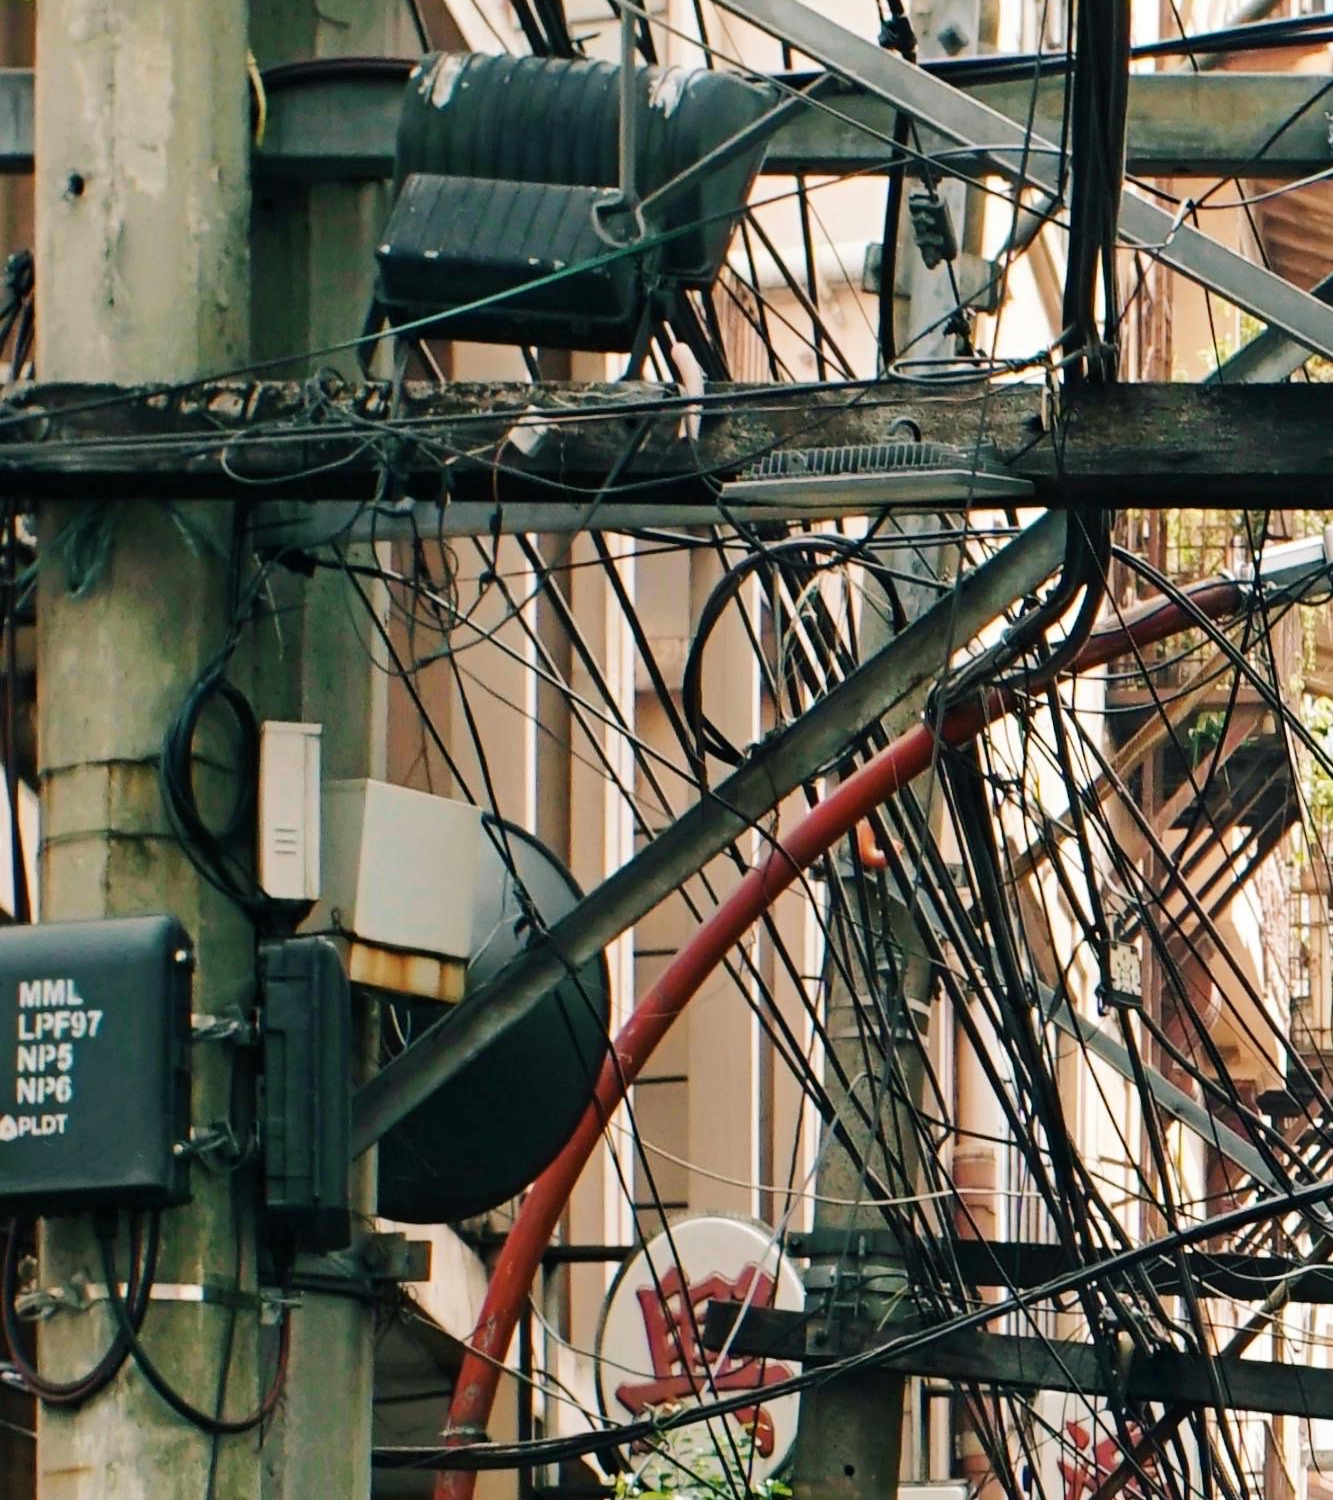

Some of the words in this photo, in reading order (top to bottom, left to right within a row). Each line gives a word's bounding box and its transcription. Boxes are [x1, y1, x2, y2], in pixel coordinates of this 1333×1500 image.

[19, 979, 84, 1008] MML
[18, 1010, 103, 1041] LPF97
[17, 1043, 73, 1073] NP5
[17, 1075, 72, 1104] NP6
[19, 1114, 68, 1137] PLDT
